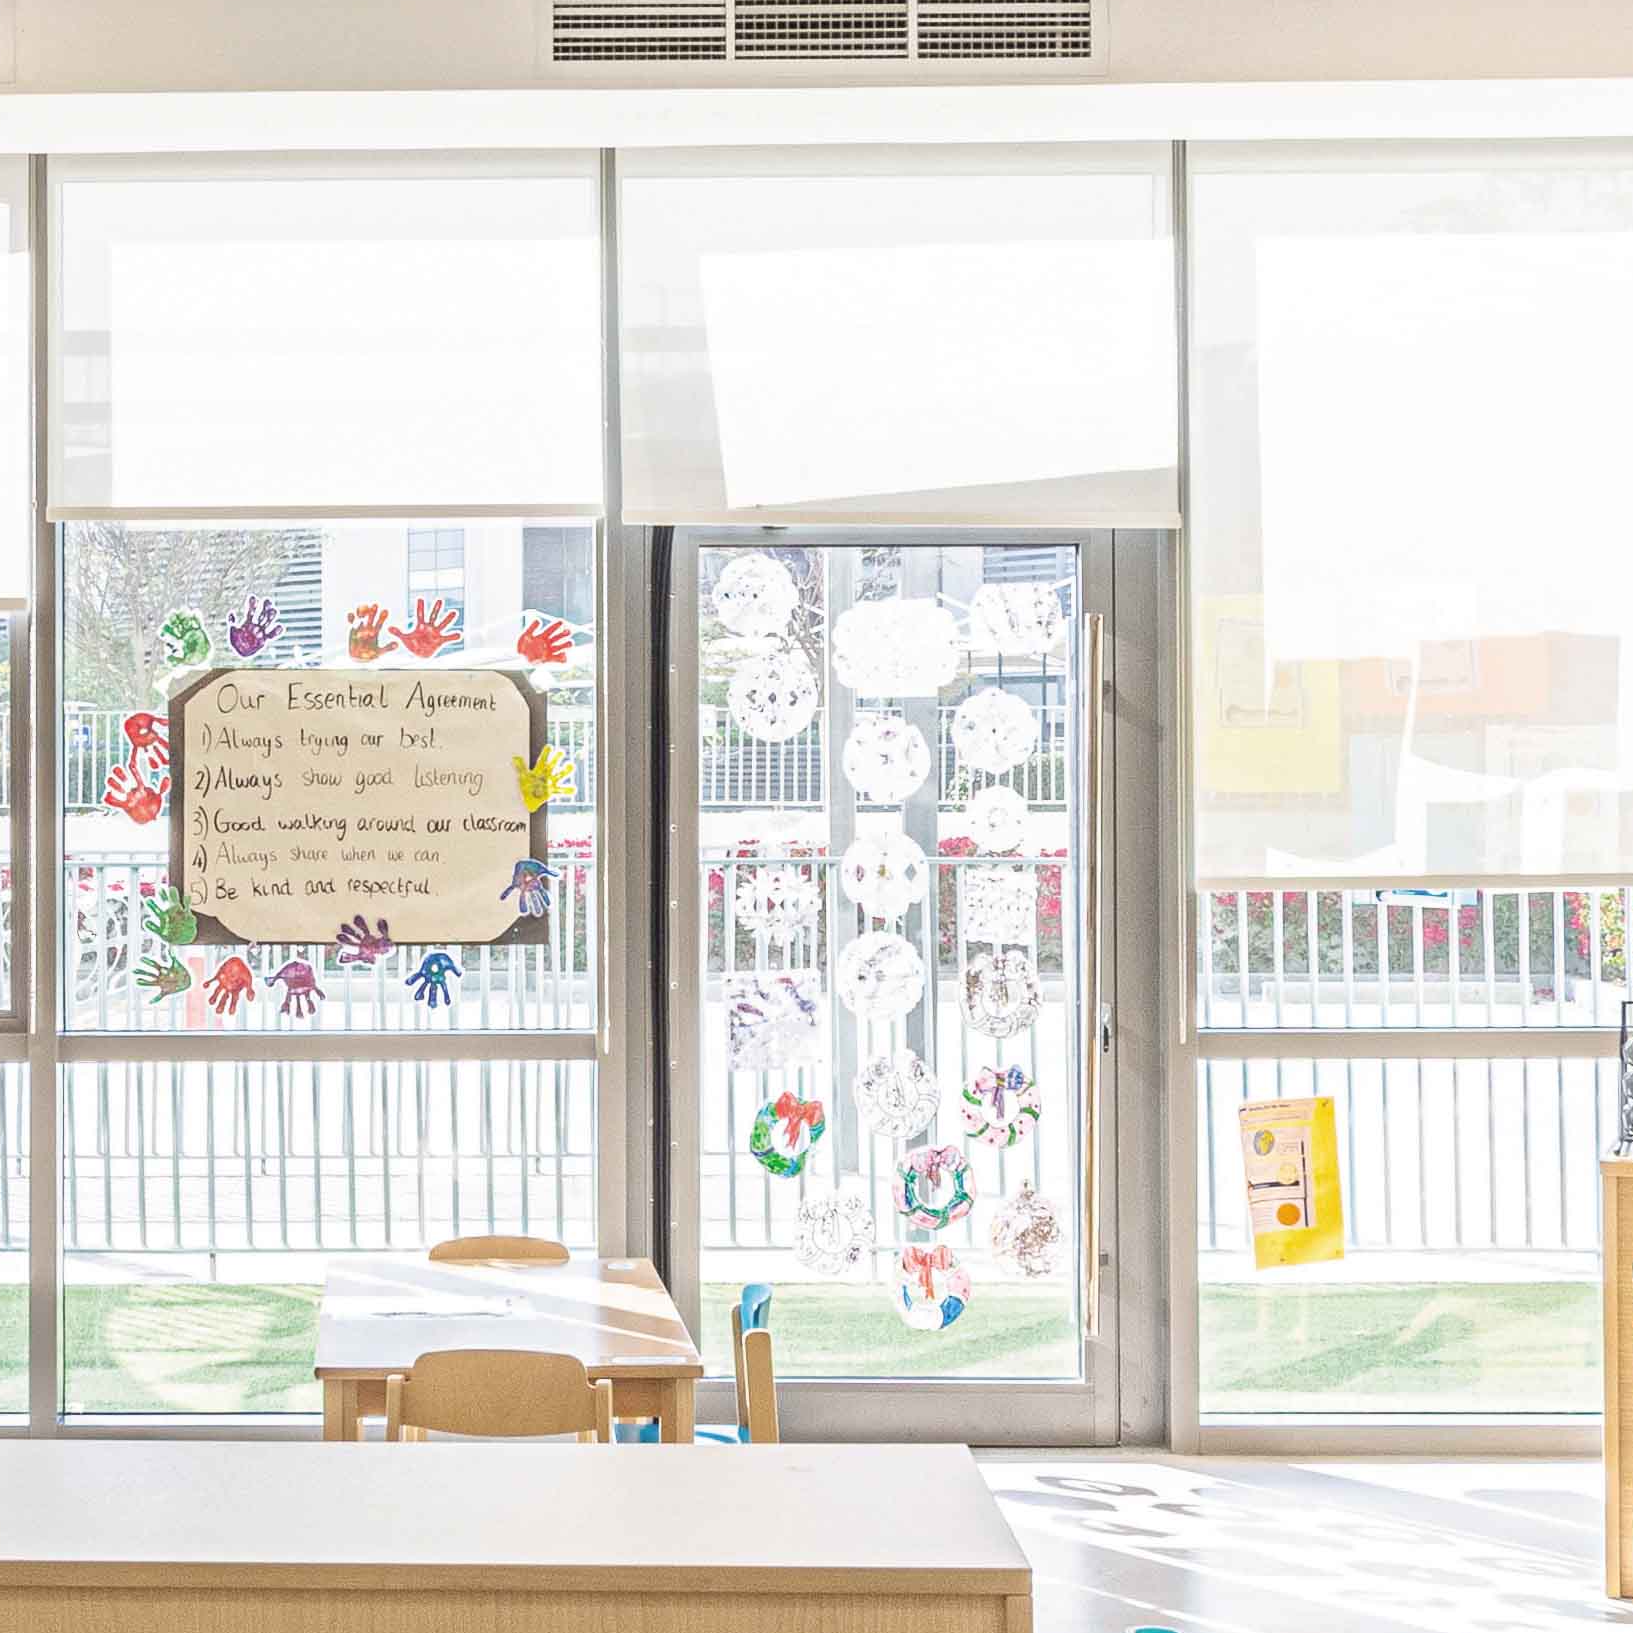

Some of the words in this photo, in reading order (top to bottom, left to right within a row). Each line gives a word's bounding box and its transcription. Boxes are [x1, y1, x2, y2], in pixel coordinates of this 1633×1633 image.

[216, 682, 265, 714] Our
[287, 681, 389, 711] Essential
[405, 680, 497, 718] Agreement
[214, 726, 284, 759] Always
[300, 727, 349, 757] trying
[360, 733, 384, 748] our
[194, 765, 211, 799] 2)
[214, 765, 283, 801] Always
[301, 768, 343, 787] show
[354, 770, 393, 795] good
[193, 805, 209, 838] 3)
[213, 808, 266, 834] Good
[277, 813, 347, 842] walking
[356, 815, 417, 833] around
[426, 819, 452, 834] our
[462, 813, 527, 833] classroom
[191, 844, 208, 873] 4)
[215, 840, 278, 872] Always
[289, 845, 329, 862] share
[340, 846, 376, 862] when
[387, 850, 404, 862] we
[215, 878, 239, 901] Be
[250, 878, 293, 897] kind
[305, 879, 336, 896] and
